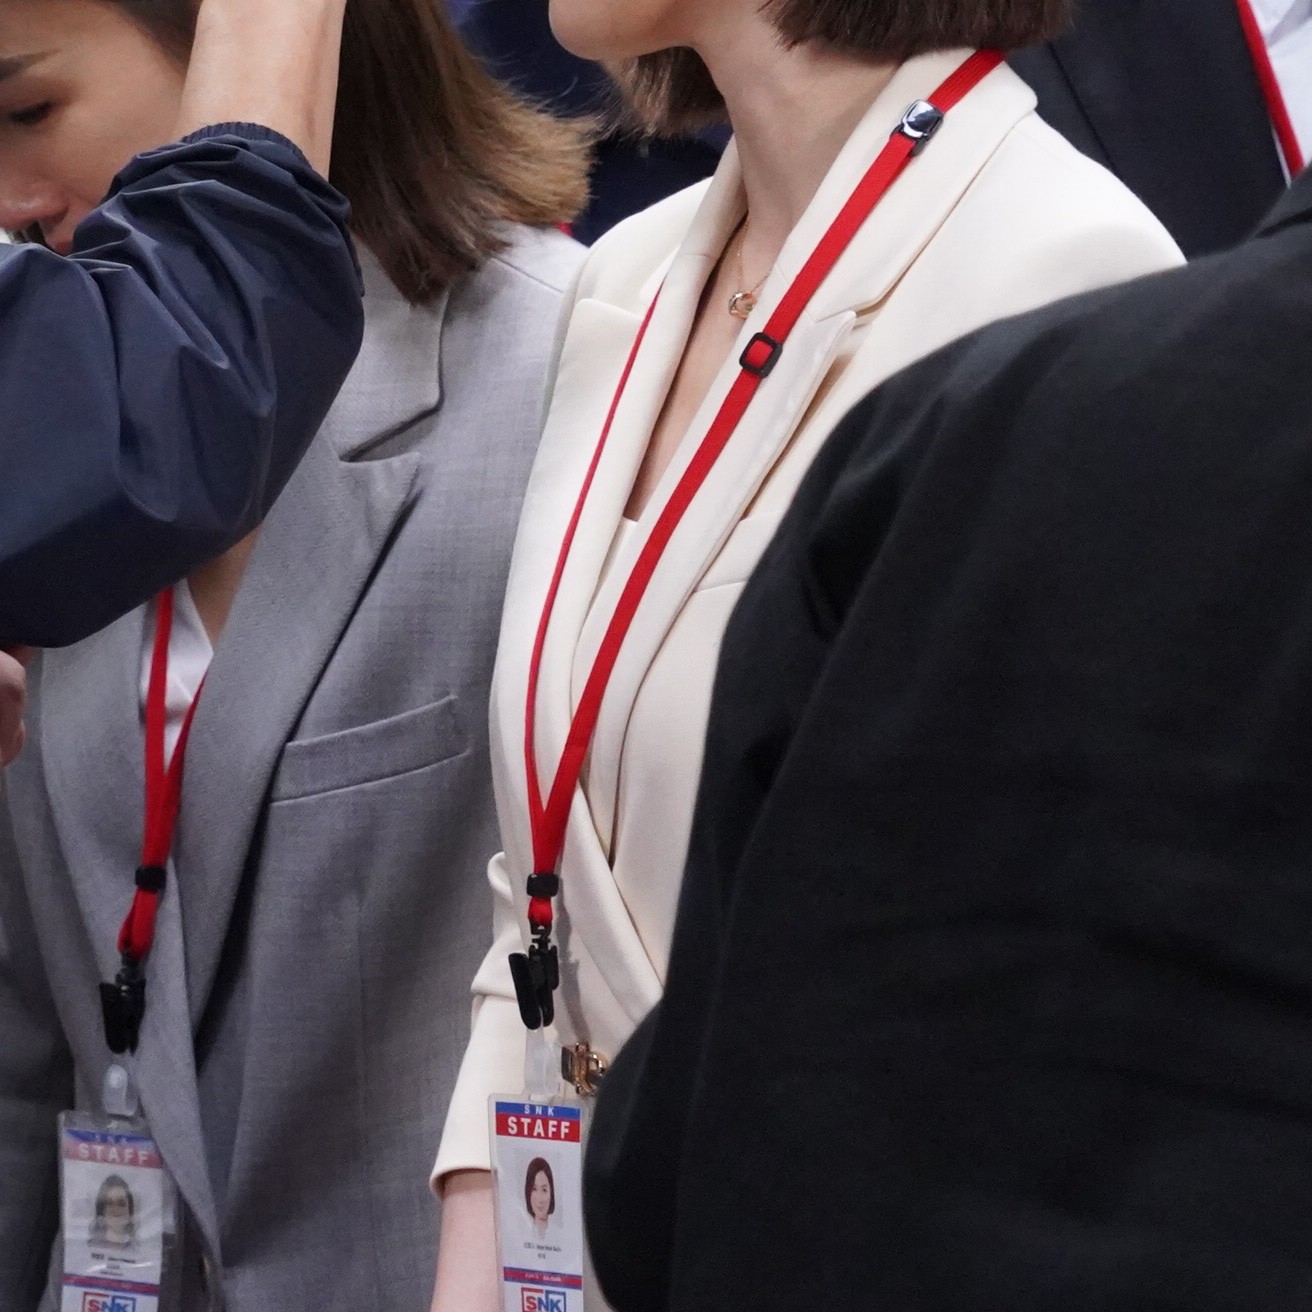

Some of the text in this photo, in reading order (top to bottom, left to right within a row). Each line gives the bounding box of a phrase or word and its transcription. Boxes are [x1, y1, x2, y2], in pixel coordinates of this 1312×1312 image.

[508, 1116, 570, 1139] STAFF
[79, 1143, 149, 1165] STAFF
[524, 1292, 564, 1312] SNK
